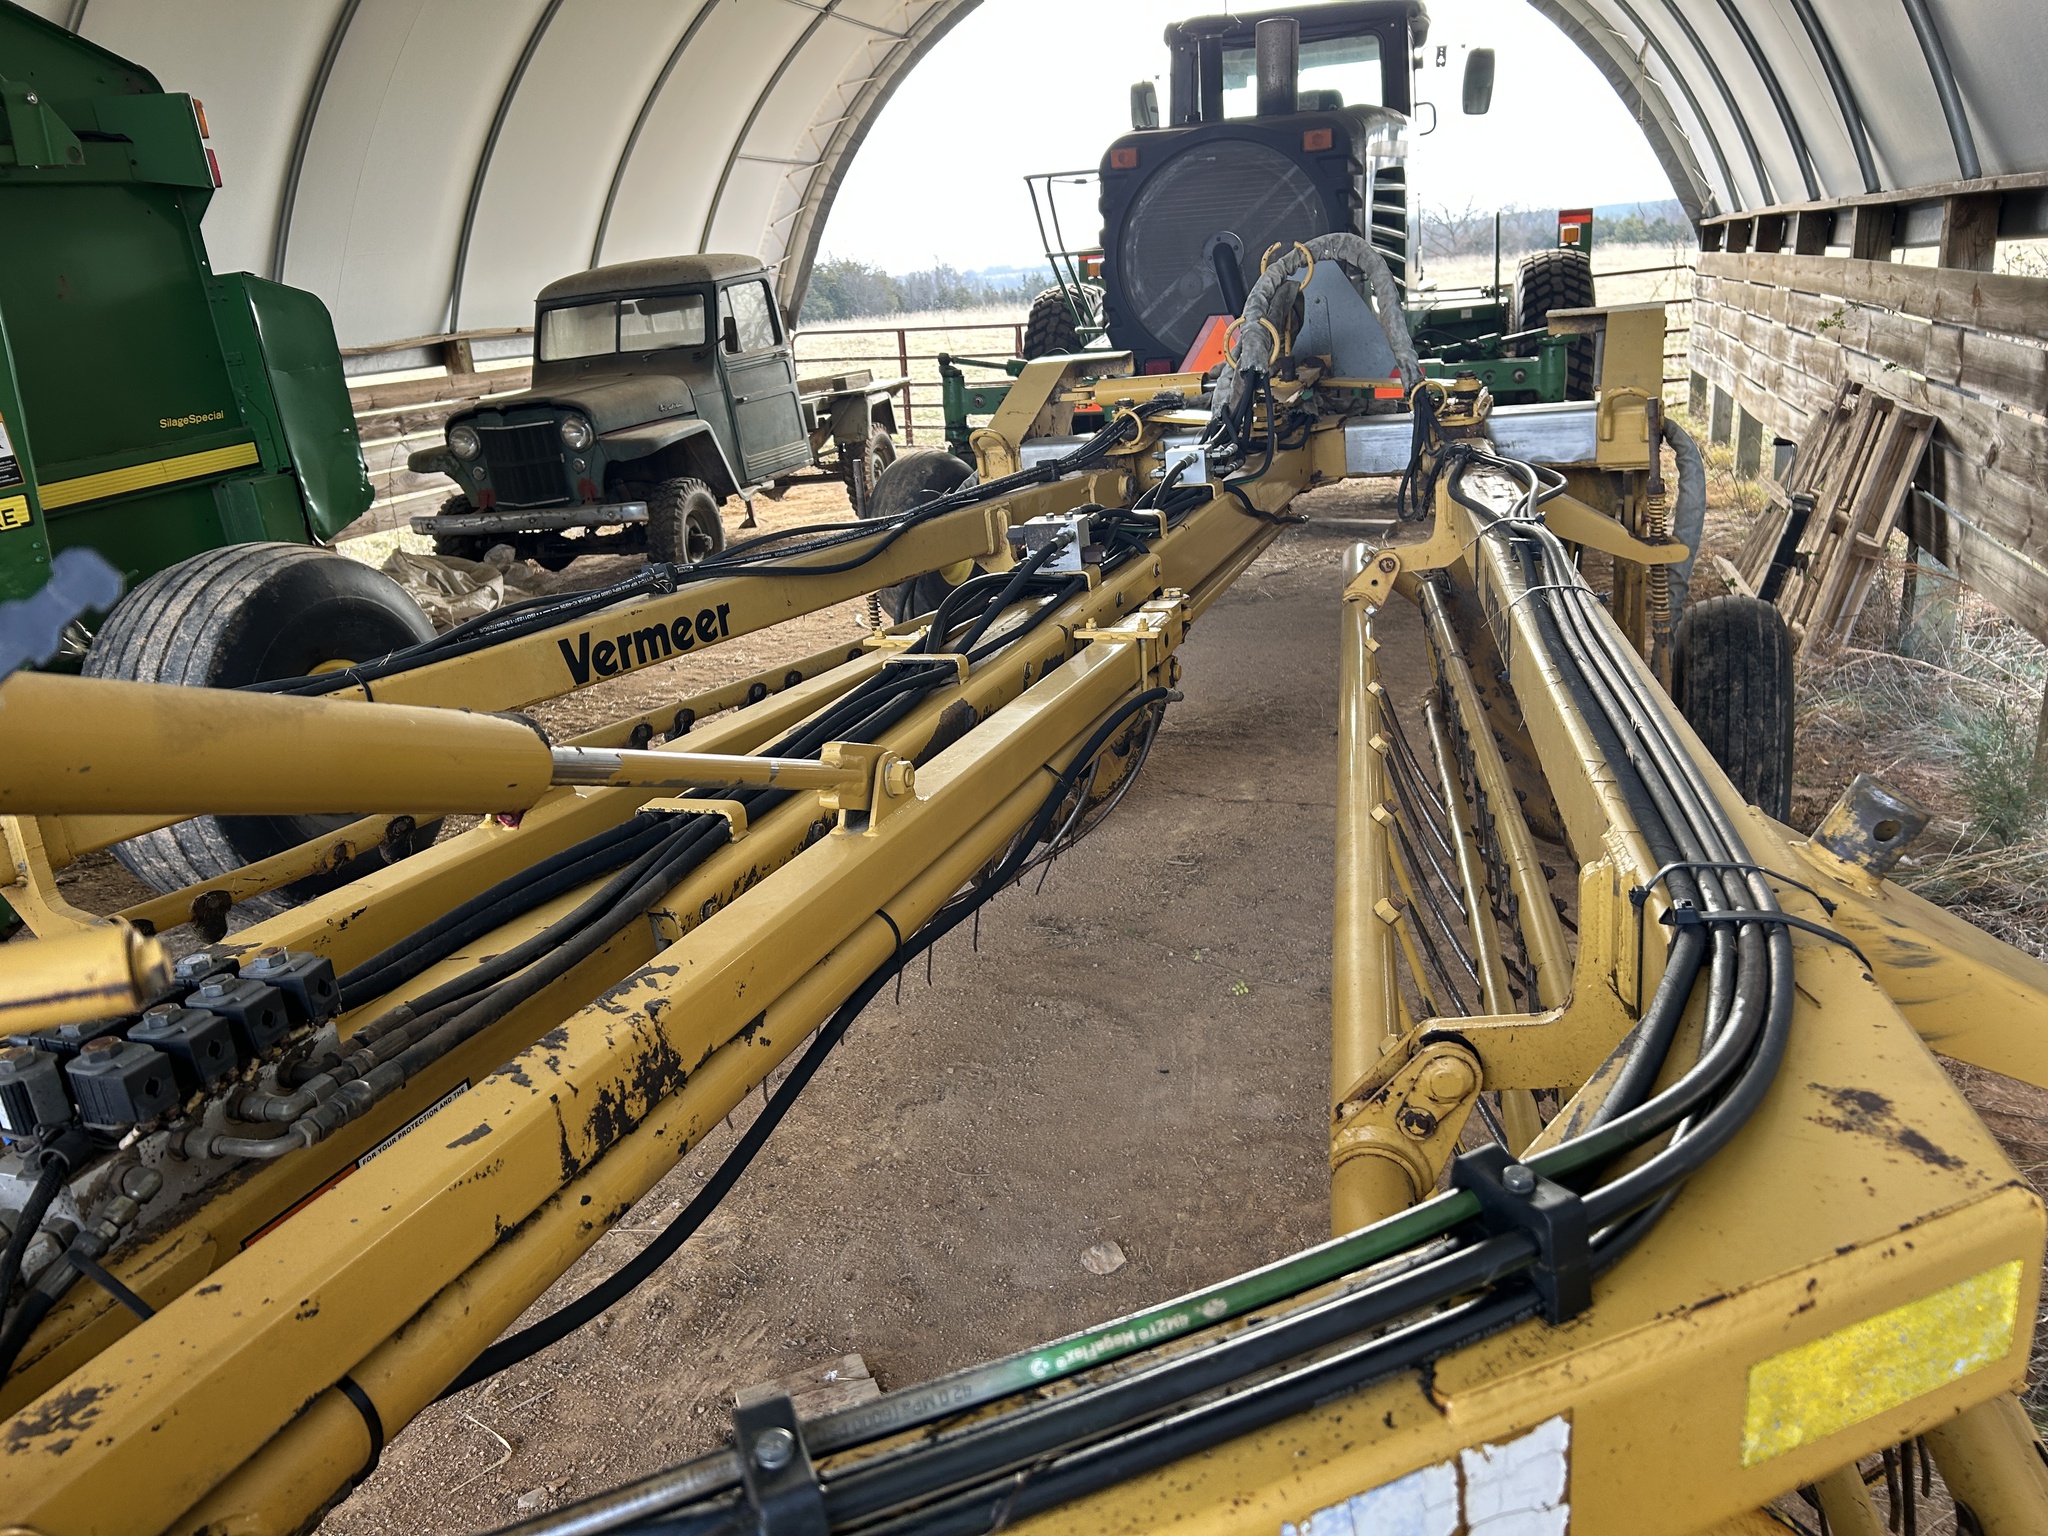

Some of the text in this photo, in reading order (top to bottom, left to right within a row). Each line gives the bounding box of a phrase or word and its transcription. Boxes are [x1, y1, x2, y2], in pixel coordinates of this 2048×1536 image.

[159, 410, 224, 428] SilageSpecial
[557, 602, 731, 686] Vermeer
[362, 1086, 466, 1166] FOR YOUR PROTECTION AND THE
